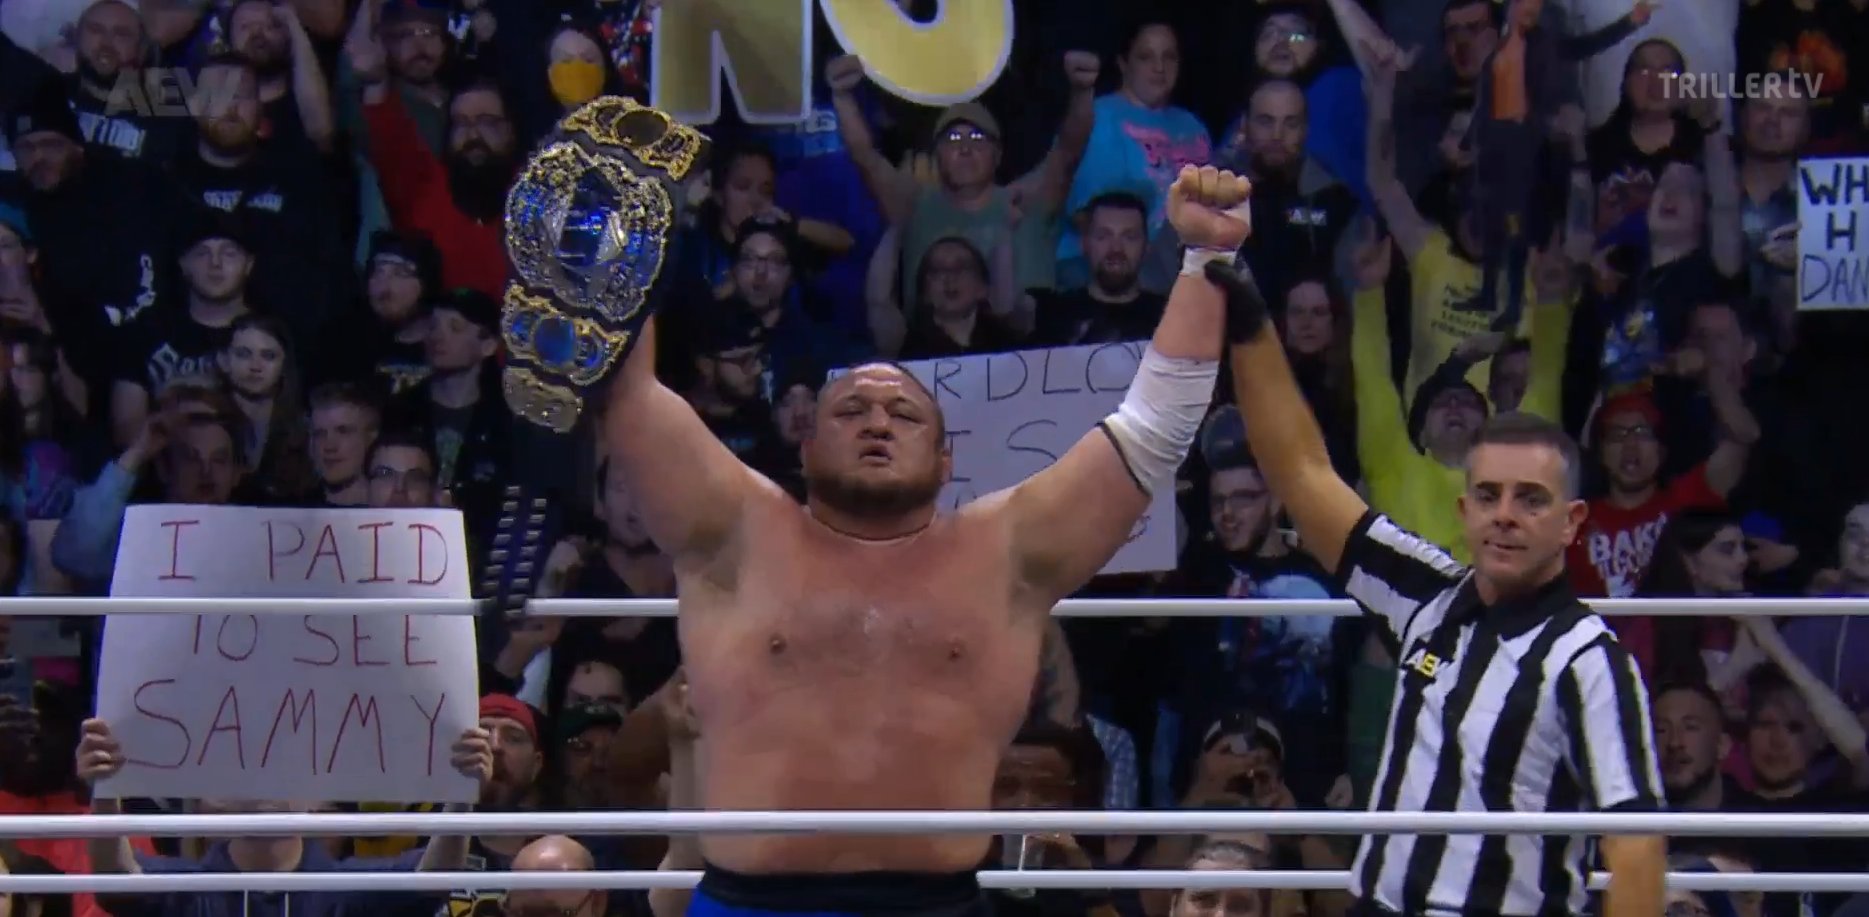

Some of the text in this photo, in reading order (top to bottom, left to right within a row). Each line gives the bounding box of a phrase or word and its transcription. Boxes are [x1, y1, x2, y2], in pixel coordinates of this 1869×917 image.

[831, 341, 1145, 402] RDLO
[158, 520, 449, 586] I PAID
[293, 615, 438, 667] SEE
[126, 678, 450, 777] SAMMY
